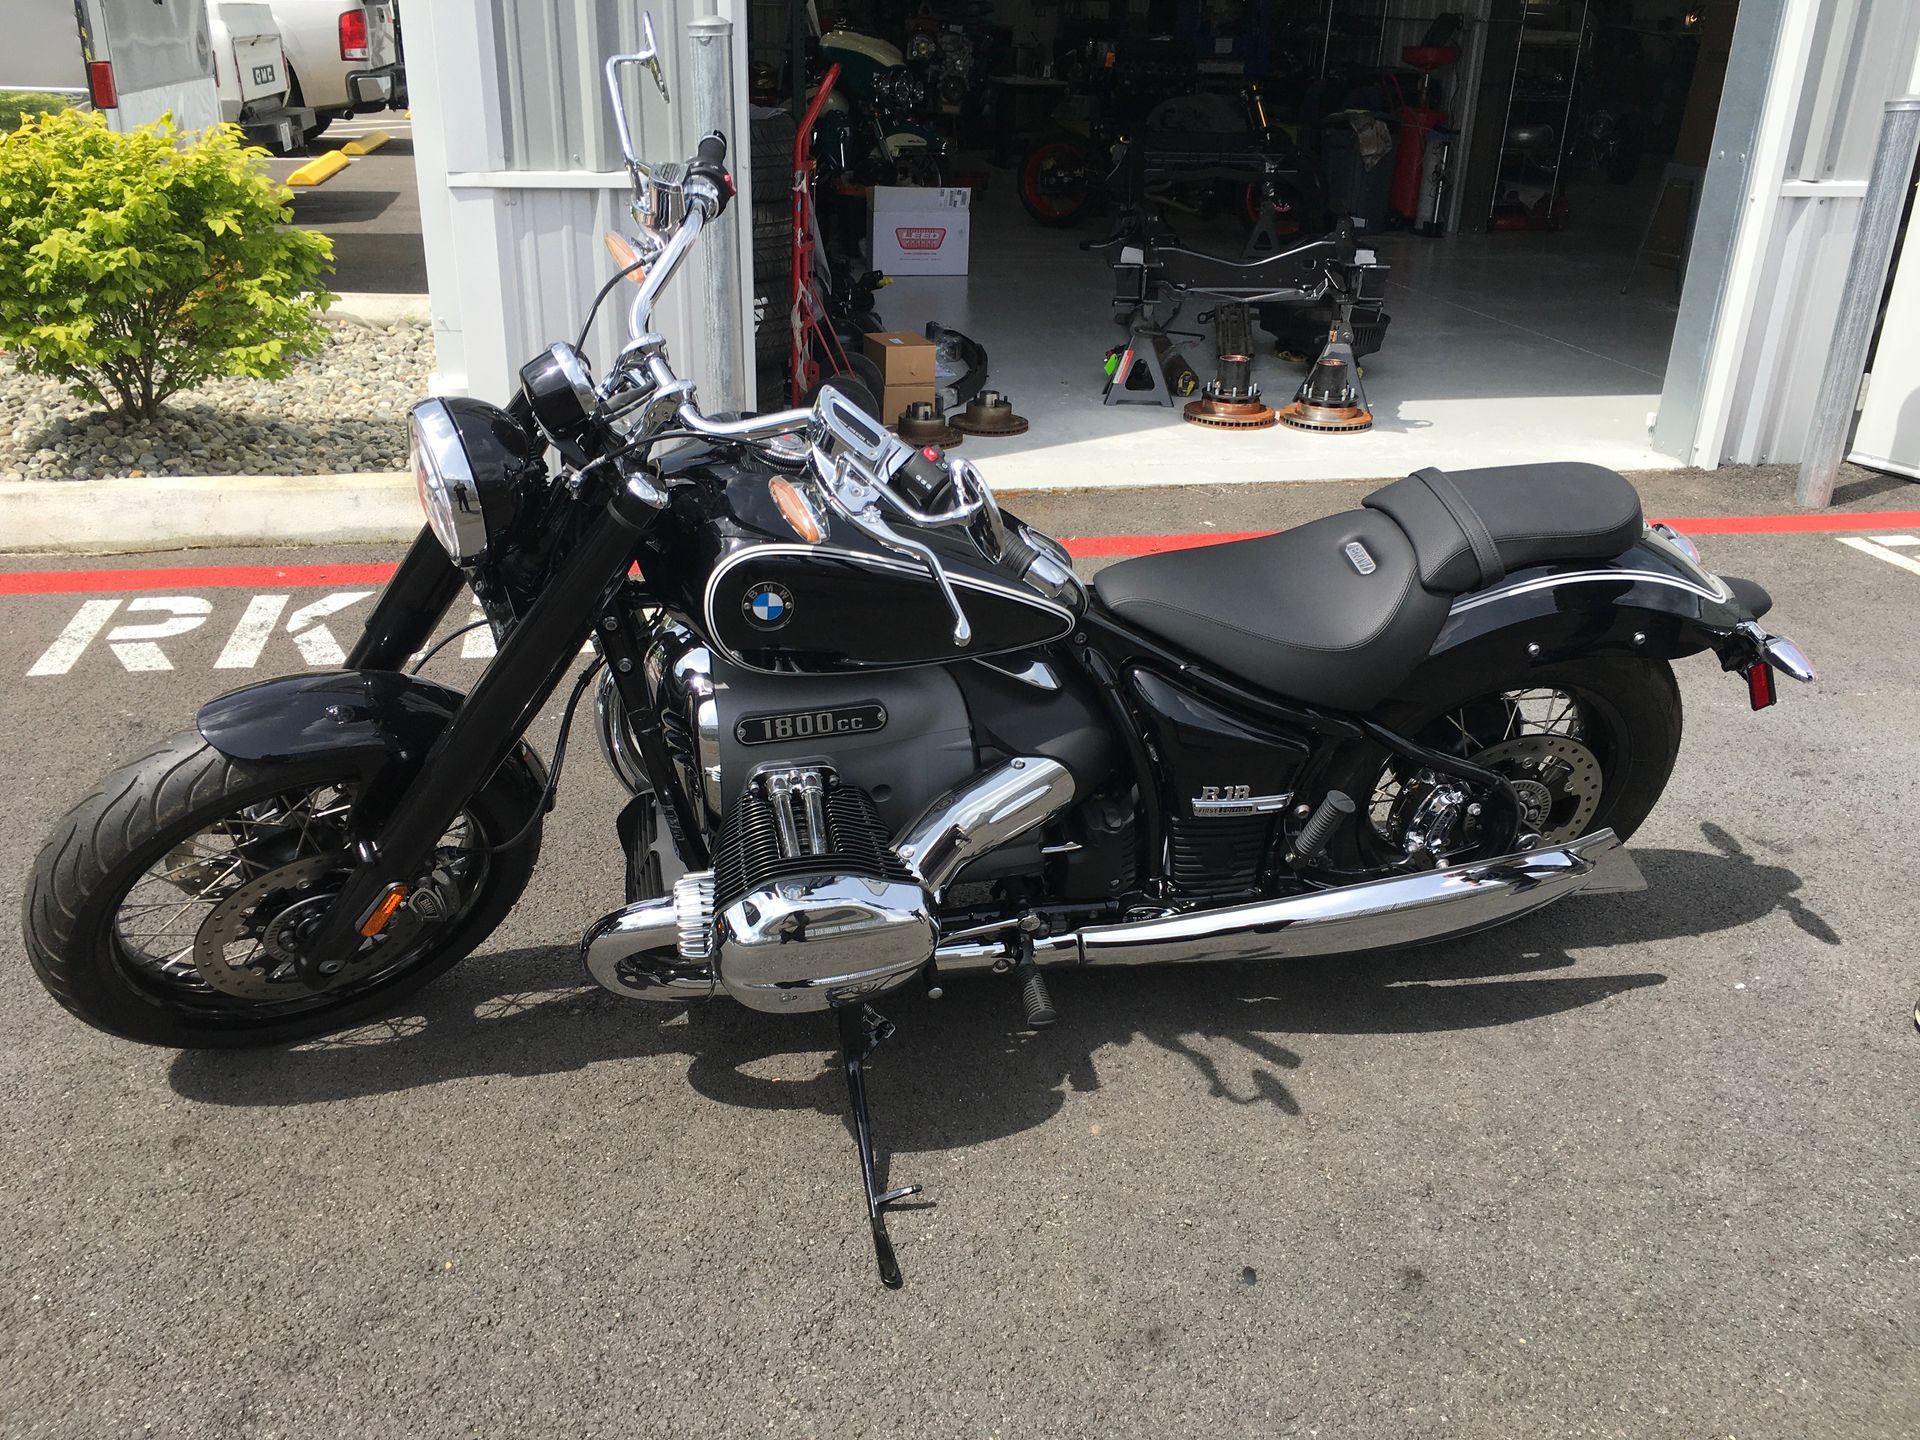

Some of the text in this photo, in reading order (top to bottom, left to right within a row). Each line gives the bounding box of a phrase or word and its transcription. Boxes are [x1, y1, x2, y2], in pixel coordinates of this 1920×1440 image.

[254, 66, 274, 84] GMC
[901, 232, 941, 240] LEED
[748, 584, 790, 600] BMW
